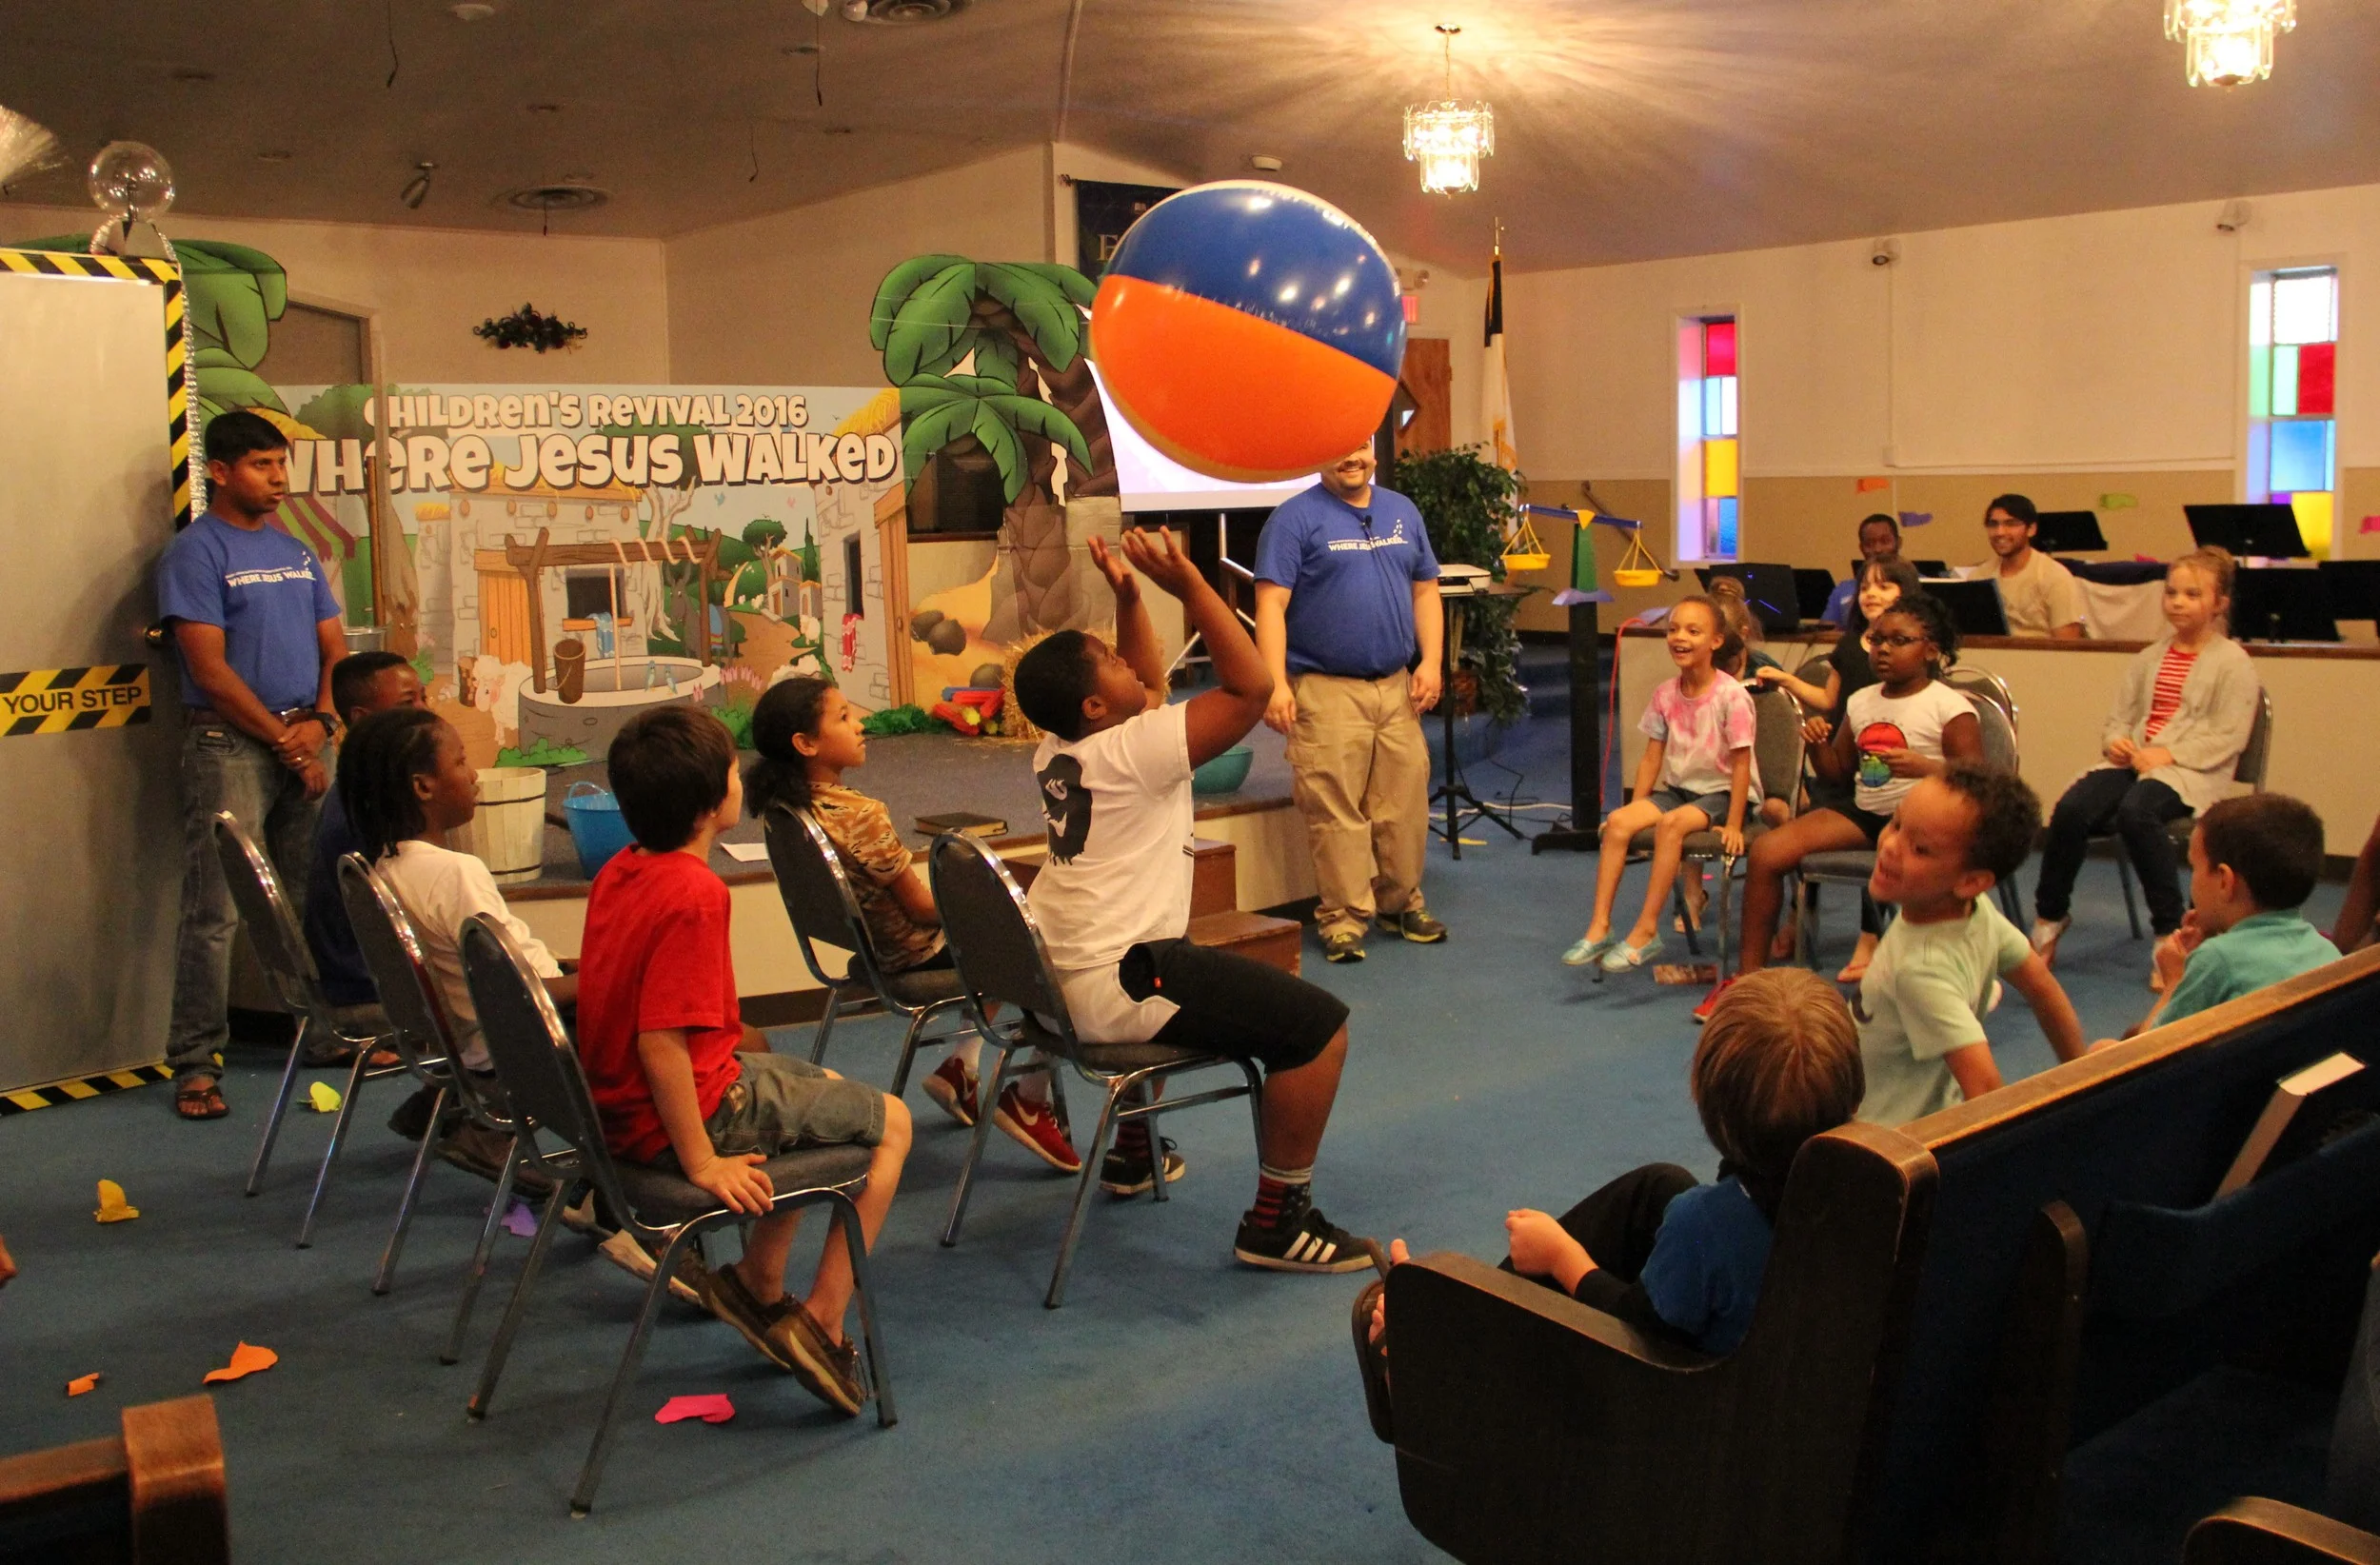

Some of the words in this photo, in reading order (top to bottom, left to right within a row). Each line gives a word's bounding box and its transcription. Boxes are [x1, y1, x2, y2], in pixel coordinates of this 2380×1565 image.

[736, 394, 809, 427] 2016
[228, 574, 262, 587] WHERE
[2, 691, 74, 714] YOUR
[82, 686, 142, 708] STEP
